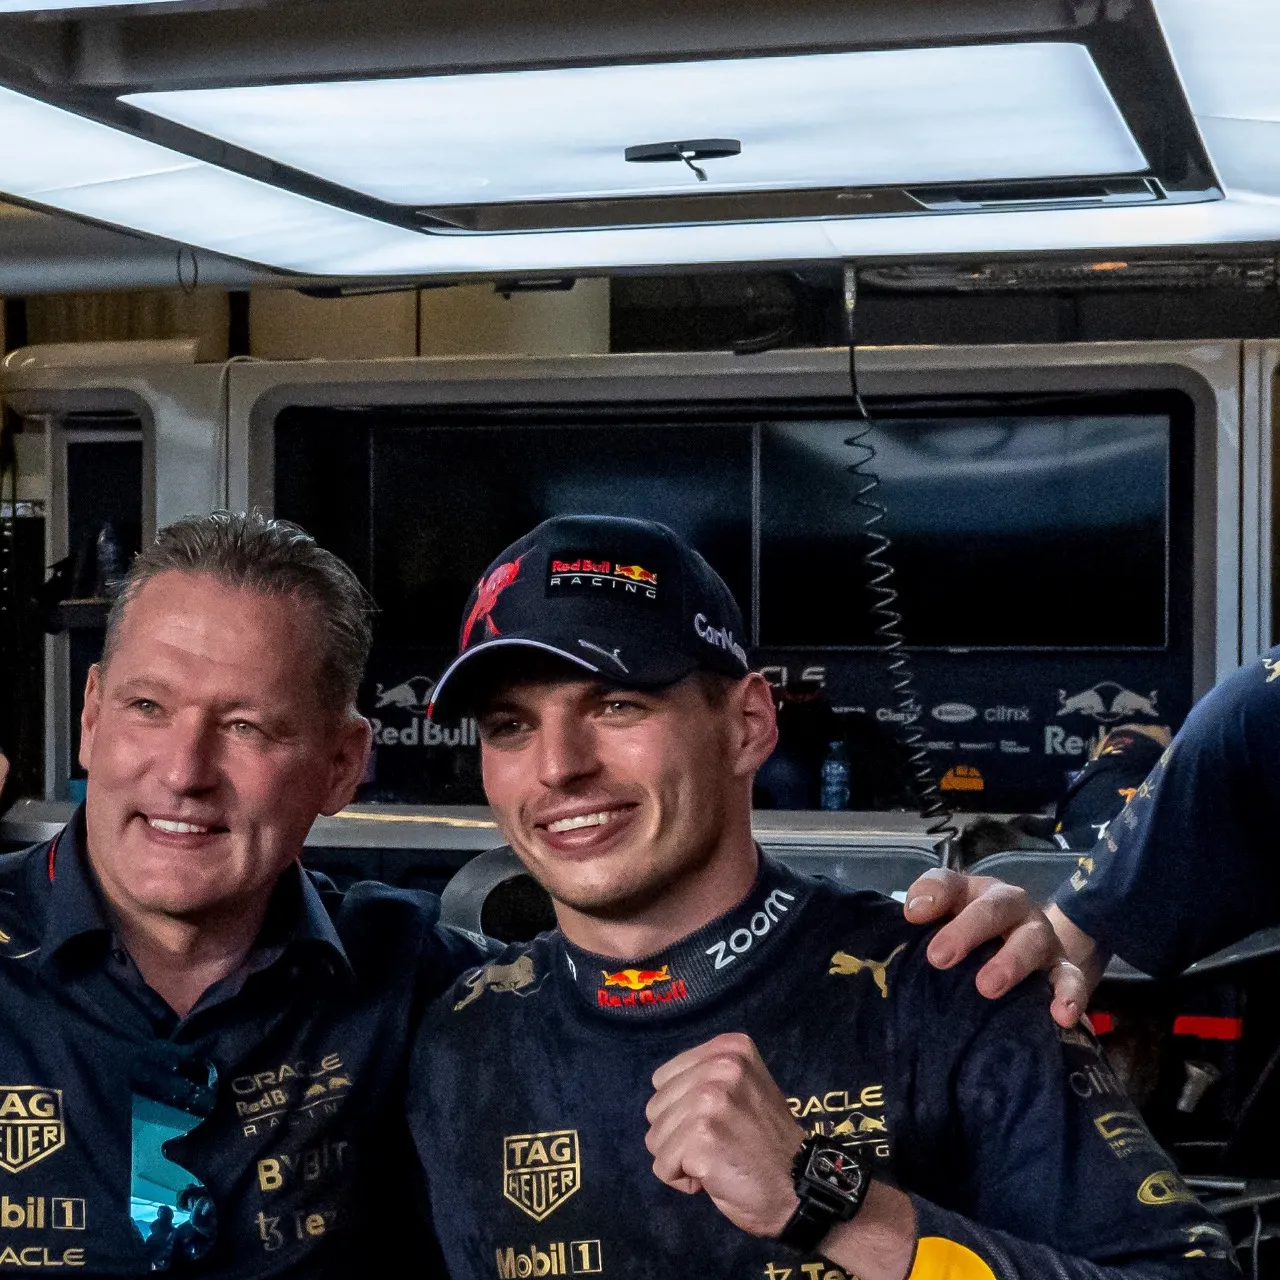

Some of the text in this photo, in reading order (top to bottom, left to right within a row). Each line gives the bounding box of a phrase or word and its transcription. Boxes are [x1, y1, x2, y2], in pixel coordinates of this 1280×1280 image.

[552, 560, 611, 575] Red Bull
[550, 576, 657, 599] RACING
[425, 718, 477, 747] Bull
[596, 978, 688, 1008] Red Bull
[786, 1084, 885, 1118] RACLE
[509, 1136, 571, 1167] TAG
[509, 1170, 574, 1214] HEUER
[496, 1242, 567, 1280] Mobil
